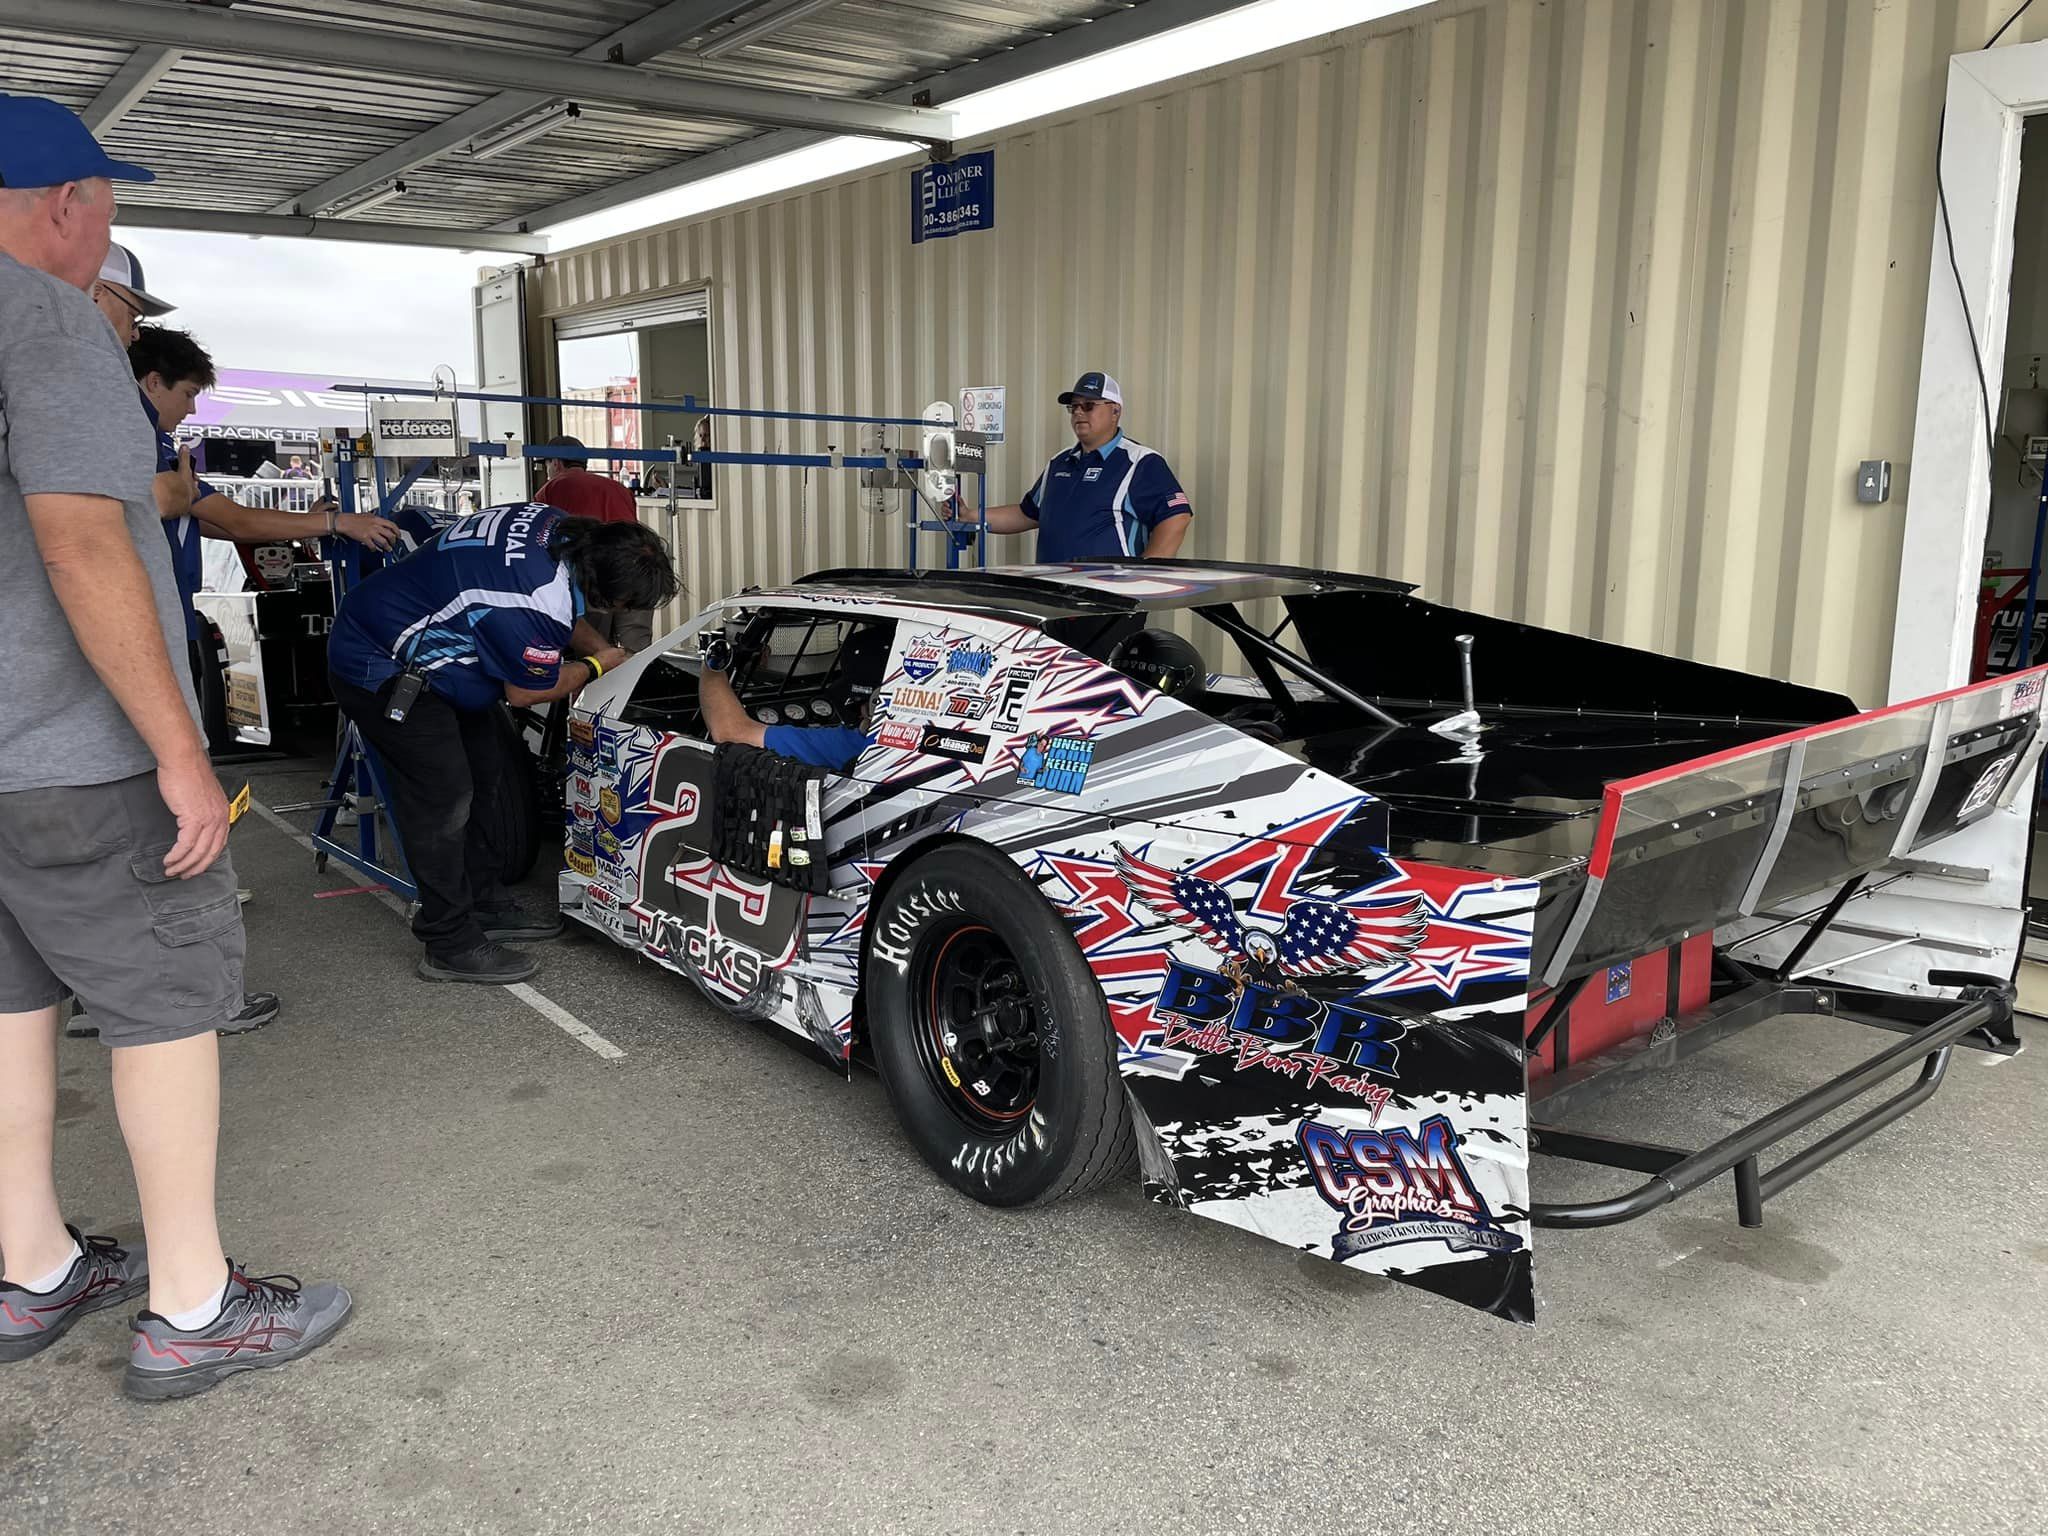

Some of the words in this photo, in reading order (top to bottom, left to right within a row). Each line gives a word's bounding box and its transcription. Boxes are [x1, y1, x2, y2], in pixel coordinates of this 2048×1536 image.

[207, 426, 284, 440] RACING
[381, 420, 451, 436] referee
[505, 502, 549, 566] OFFICIAL
[908, 646, 941, 660] LUCAS
[912, 661, 937, 669] PRODUCTS
[1008, 670, 1036, 680] FACTORY
[892, 687, 944, 711] LiUNA!
[881, 722, 902, 740] Motor
[902, 724, 919, 744] City
[1052, 737, 1096, 753] UNCLE
[1046, 757, 1089, 774] KELLER
[873, 880, 967, 976] Hoosier
[1155, 958, 1408, 1079] BBR
[1157, 1012, 1235, 1055] Battle
[1230, 1031, 1304, 1080] Born
[1288, 1051, 1394, 1128] Racing
[1298, 1116, 1481, 1212] CSM
[1346, 1184, 1455, 1231] Graphics
